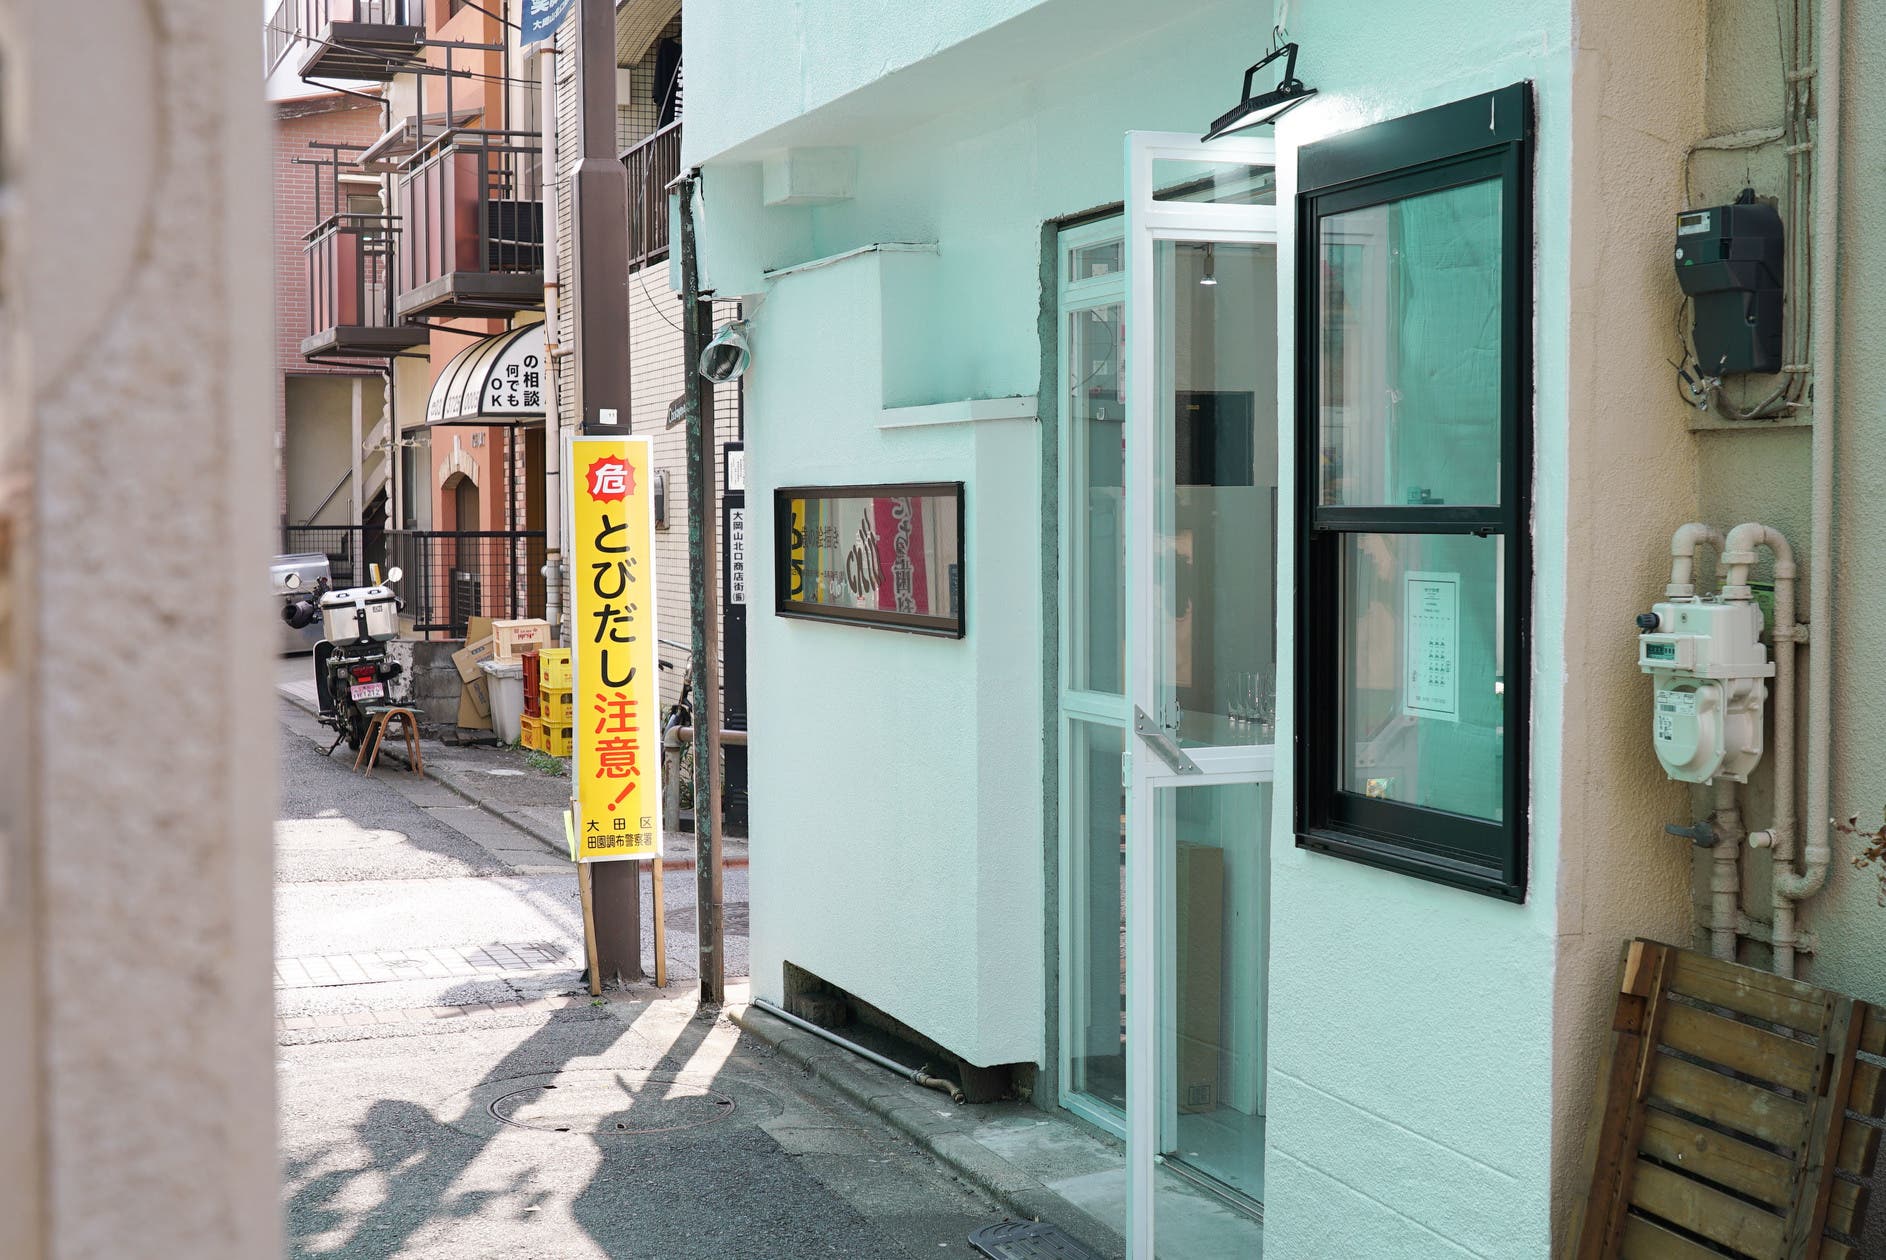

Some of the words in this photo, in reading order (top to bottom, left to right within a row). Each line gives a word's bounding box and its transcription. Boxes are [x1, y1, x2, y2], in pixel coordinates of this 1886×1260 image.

[491, 378, 503, 407] OK
[506, 364, 520, 407] 何でも
[523, 355, 540, 407] の相談
[592, 463, 628, 495] 危
[586, 816, 653, 833] 大田区
[587, 832, 653, 849] 田園調布警察署
